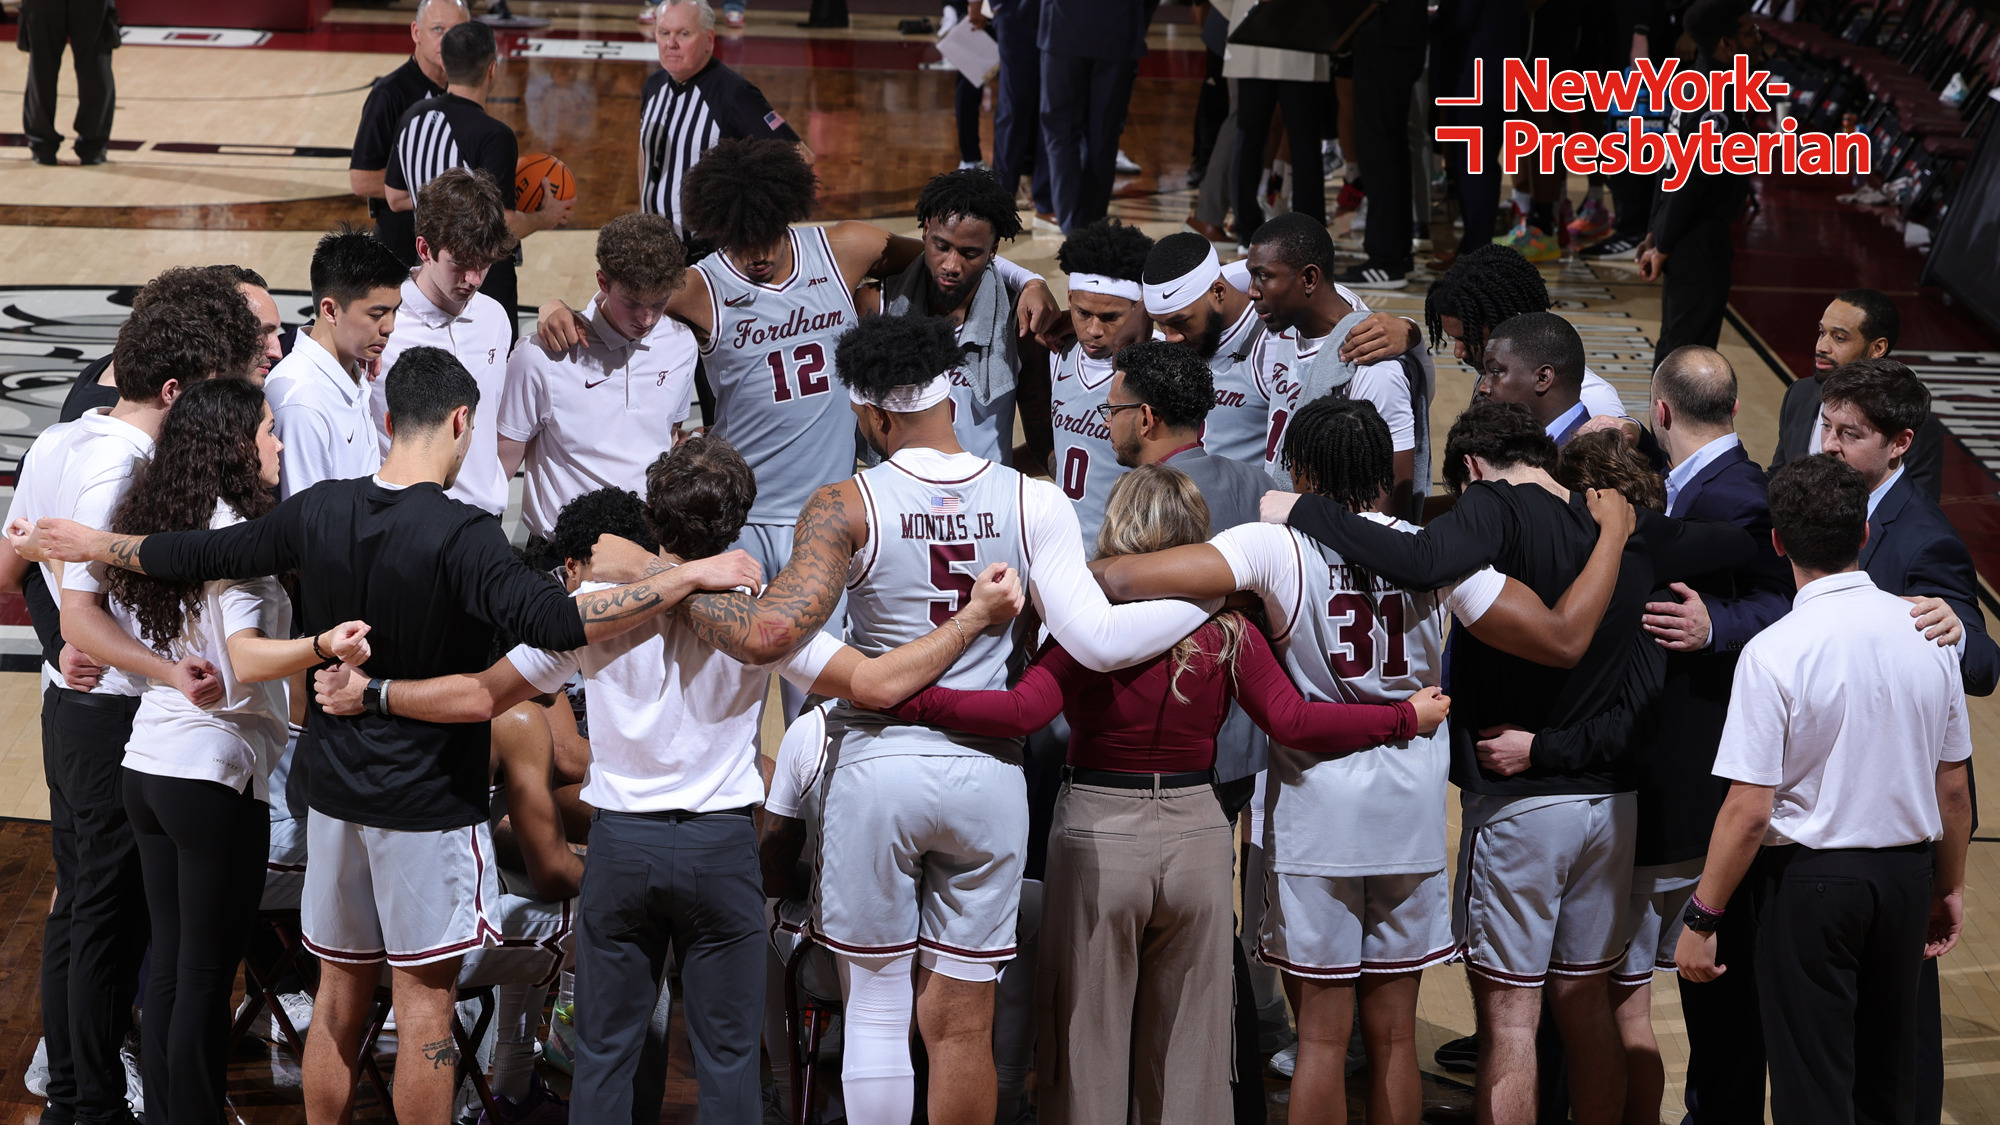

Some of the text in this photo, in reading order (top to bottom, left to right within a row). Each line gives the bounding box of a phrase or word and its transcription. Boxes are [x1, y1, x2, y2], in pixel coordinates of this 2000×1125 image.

[733, 306, 846, 349] Fordham
[765, 340, 832, 404] 12
[1051, 399, 1111, 441] Fordha
[1062, 444, 1091, 503] 0
[899, 512, 1001, 541] MONTAS JR.
[926, 540, 979, 630] 5
[1325, 589, 1411, 682] 31
